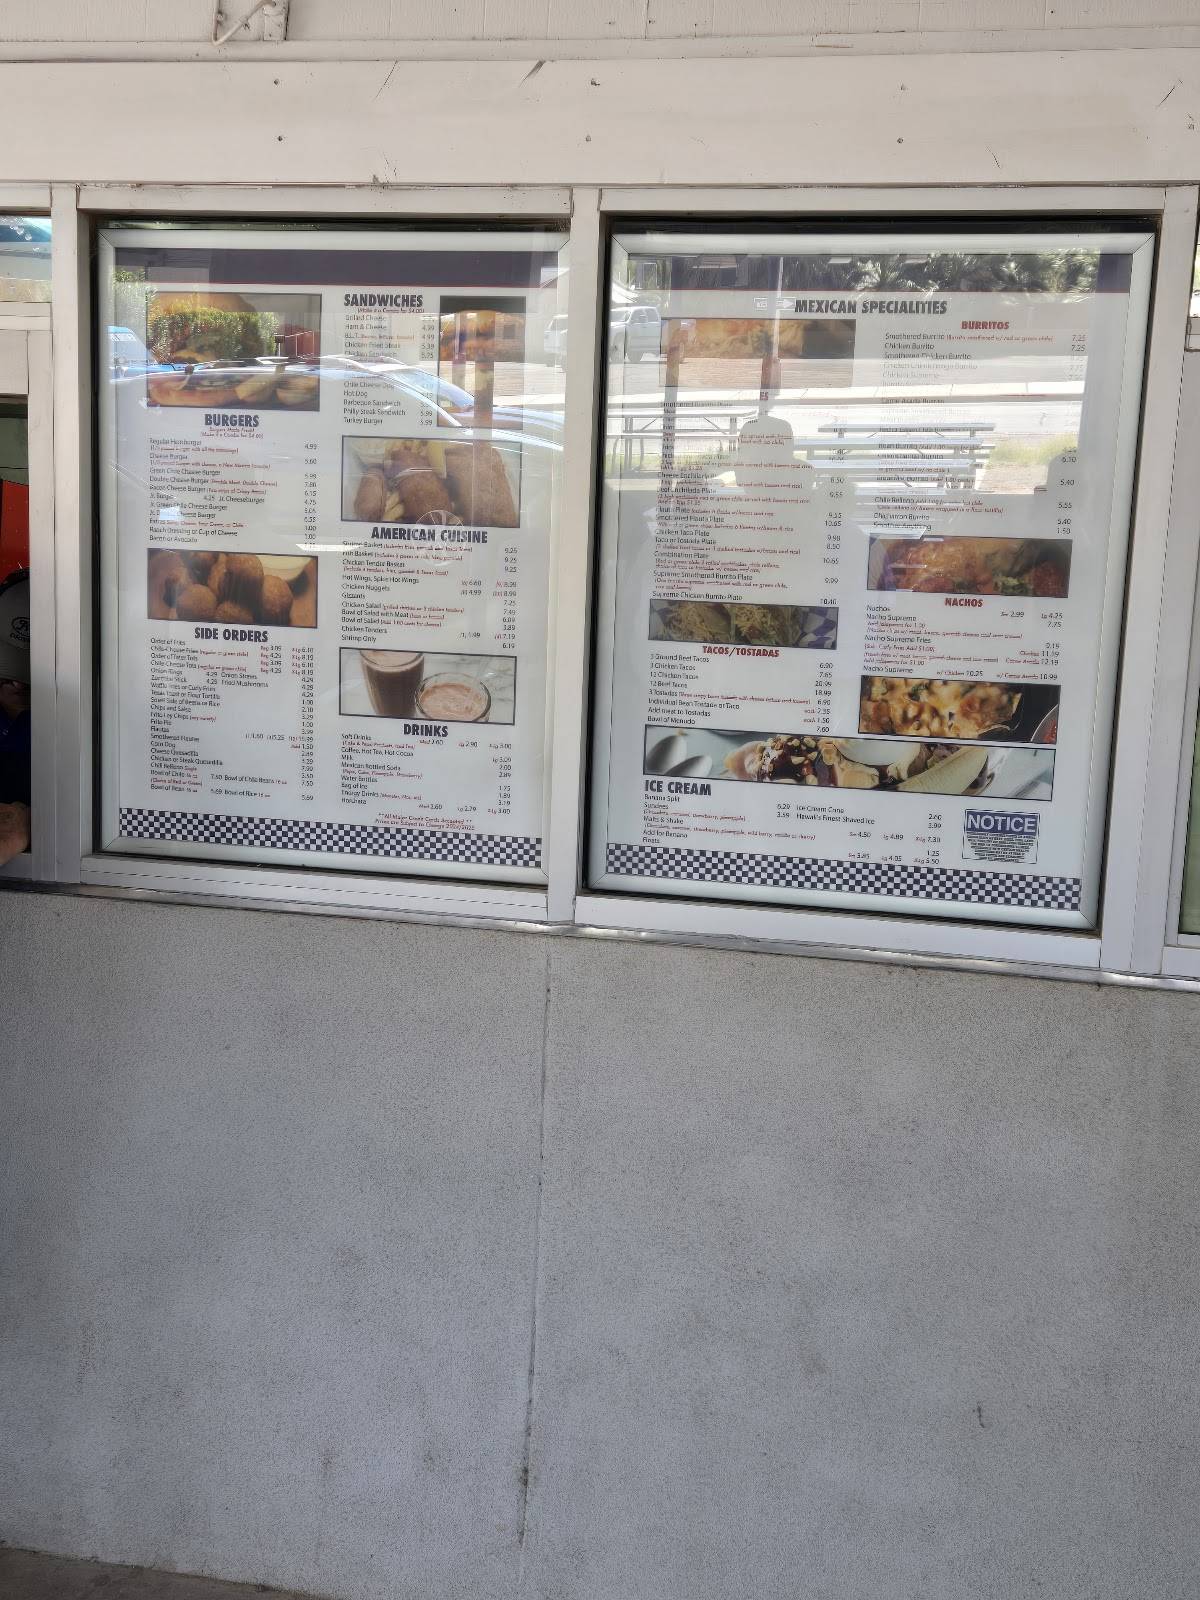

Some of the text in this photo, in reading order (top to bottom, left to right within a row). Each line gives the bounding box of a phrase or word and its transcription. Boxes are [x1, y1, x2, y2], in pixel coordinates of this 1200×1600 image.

[344, 294, 423, 307] SANDWICHES
[794, 300, 947, 315] MEXICAN SPECIALITIES
[961, 321, 1009, 329] BURRITOS
[205, 414, 259, 427] BURGERS
[371, 527, 487, 543] AMERICAN CUISINE
[944, 598, 983, 608] NACHOS
[195, 627, 268, 642] SIDE ORDERS
[703, 646, 779, 657] TACOS/TOSTADAS
[404, 724, 448, 737] DRINKS
[645, 780, 711, 796] ICE CREAM
[968, 815, 1035, 832] NOTICE
